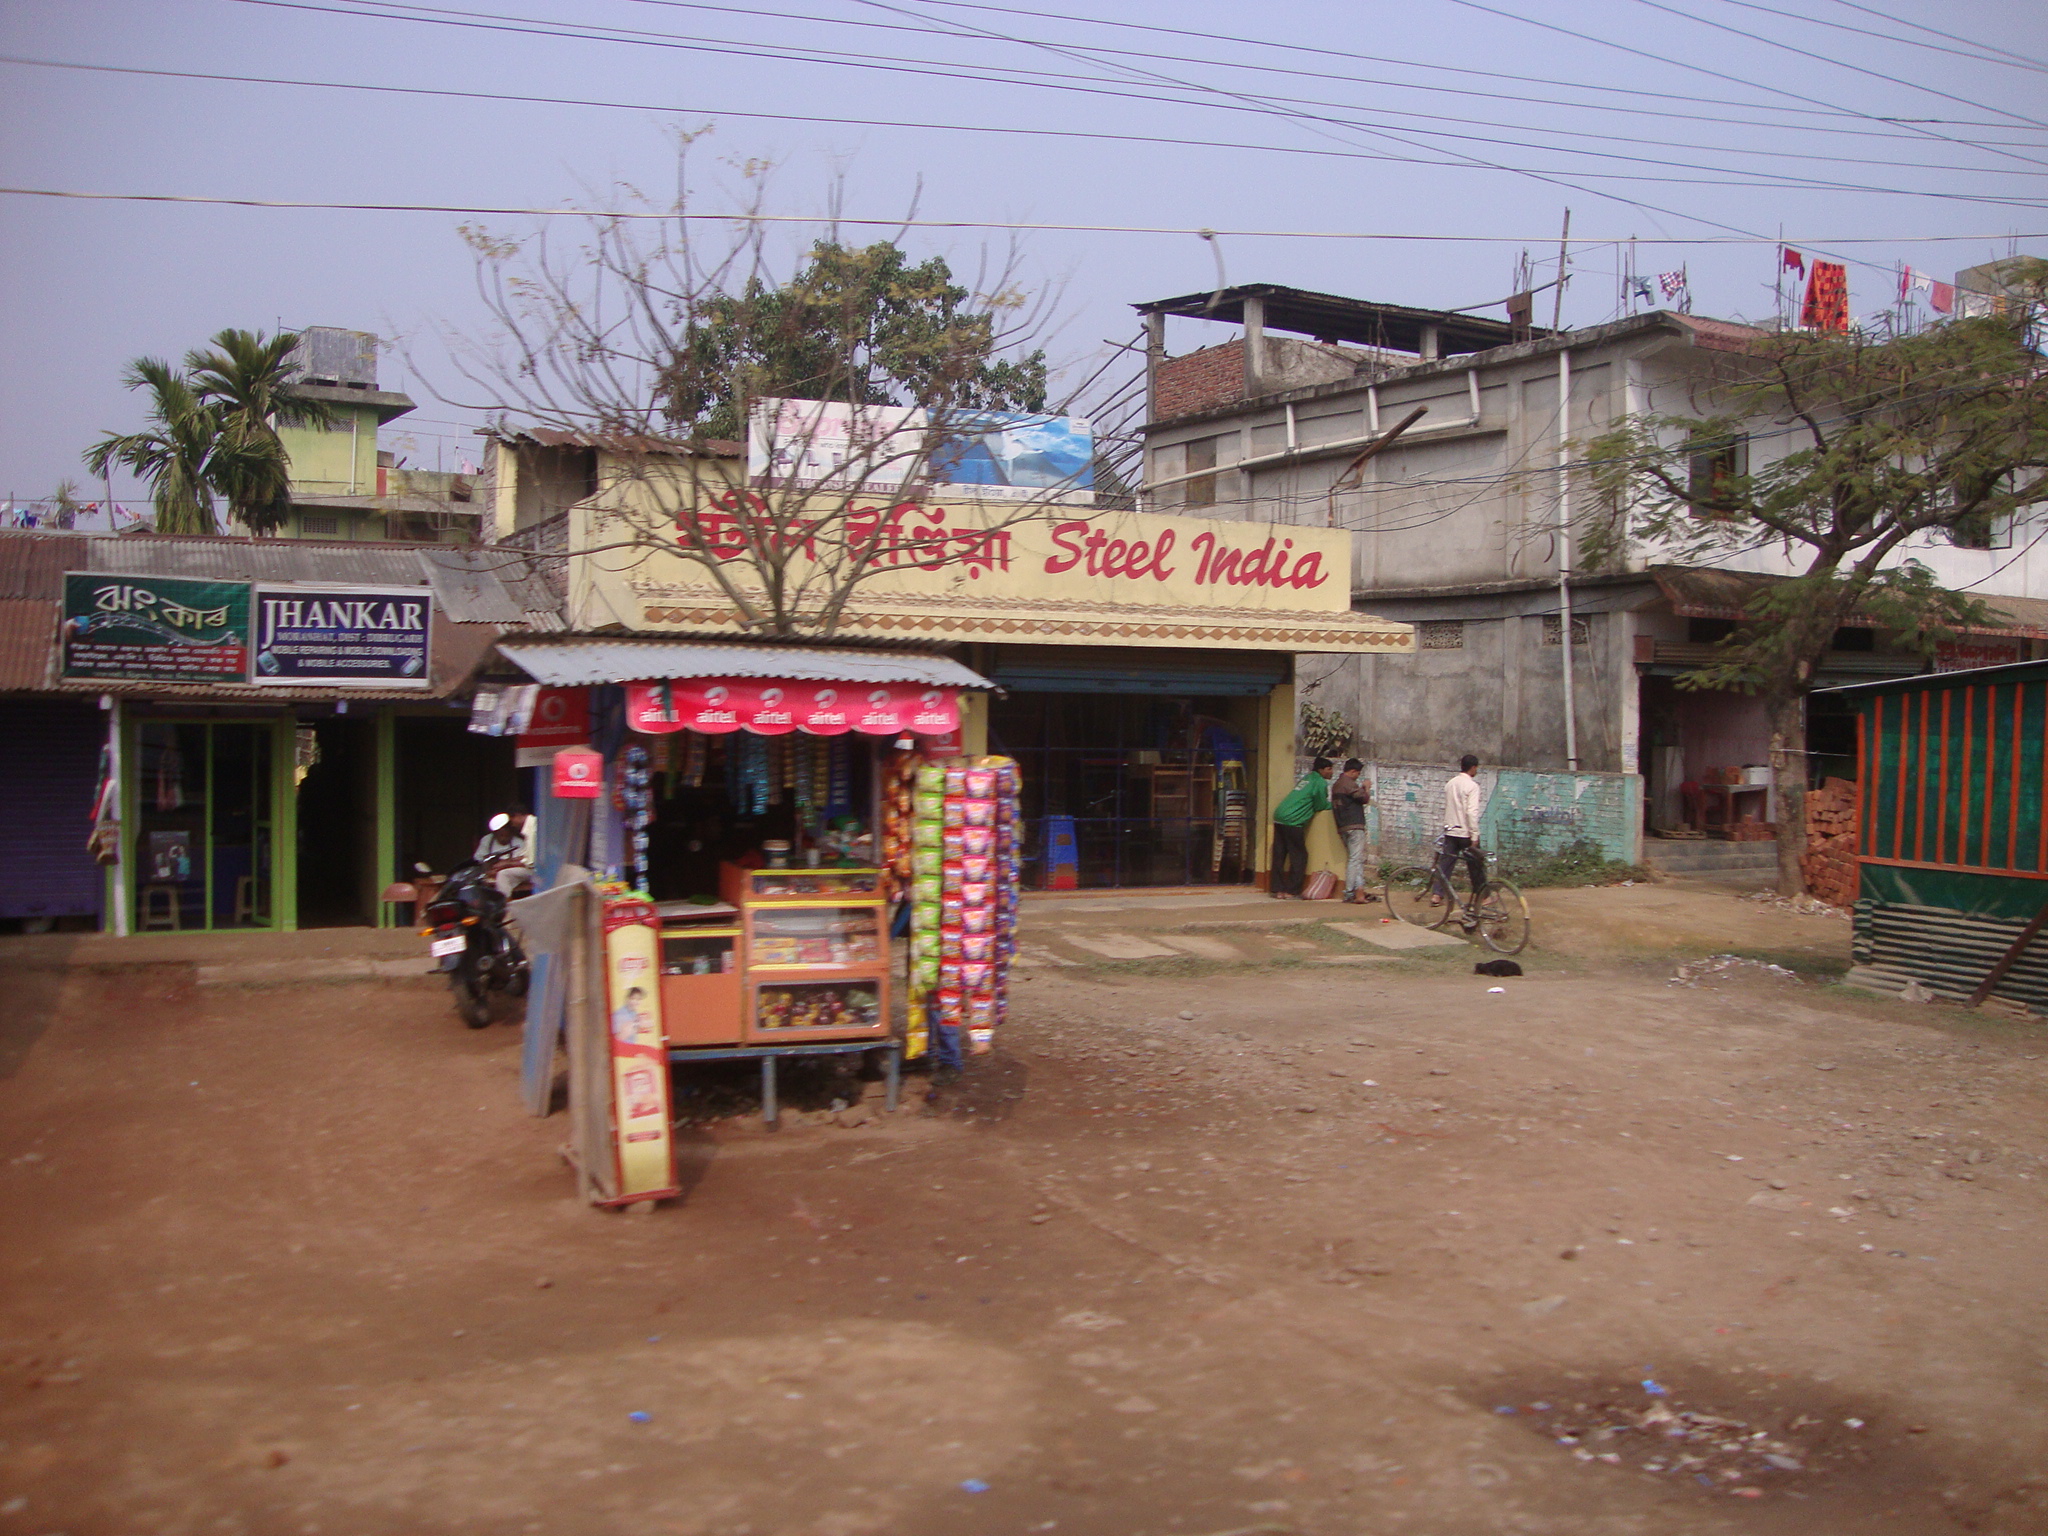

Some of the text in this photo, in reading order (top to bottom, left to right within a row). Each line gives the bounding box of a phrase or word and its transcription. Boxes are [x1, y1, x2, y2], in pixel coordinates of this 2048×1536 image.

[1044, 520, 1329, 589] Steel India
[261, 600, 424, 649] JHANKAR
[271, 645, 300, 655] MOBILE
[300, 646, 337, 655] REPAIRING
[344, 646, 371, 655] MOBILE
[372, 646, 424, 656] DOWNLOADING
[305, 659, 336, 668] MOBILE
[696, 709, 737, 723] airtel
[753, 711, 793, 724] airtel
[807, 711, 846, 725] airtel
[861, 711, 899, 725] airtel
[914, 711, 951, 725] airtel
